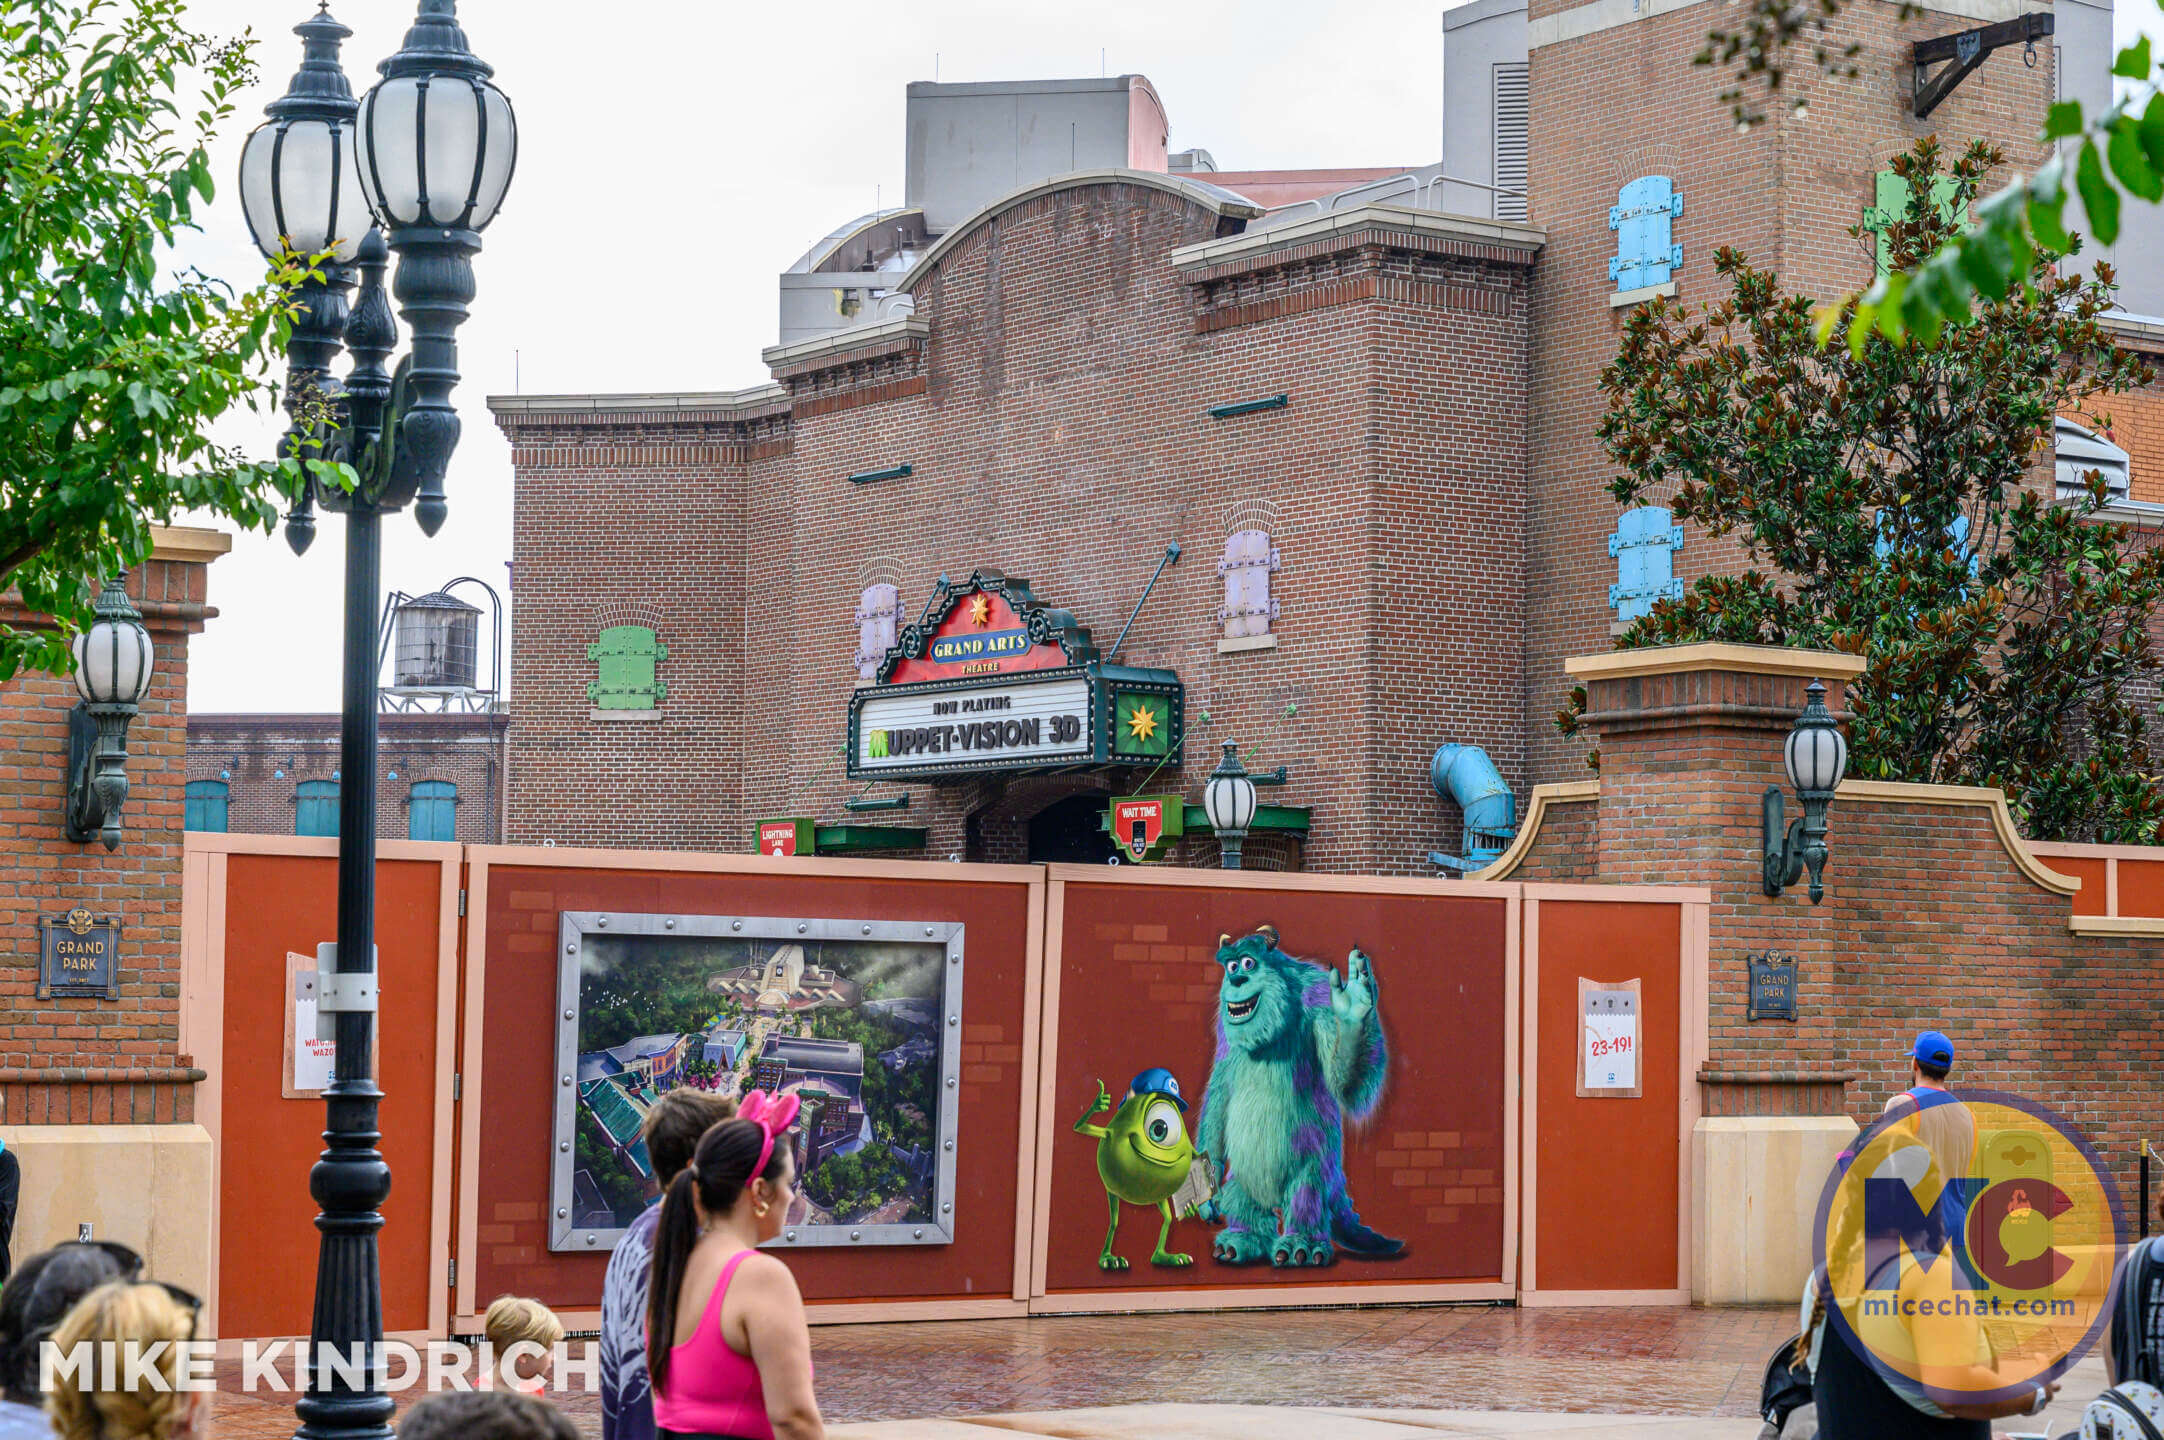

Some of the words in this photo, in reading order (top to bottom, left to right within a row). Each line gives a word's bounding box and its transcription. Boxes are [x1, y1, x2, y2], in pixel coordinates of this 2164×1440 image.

[935, 640, 984, 657] GRAND
[988, 634, 1026, 652] ARTS
[962, 662, 999, 674] THEATRE
[933, 701, 958, 715] NOW
[962, 696, 1011, 713] PLAYING
[1049, 715, 1081, 744] 3D
[1122, 807, 1138, 818] WAIT
[1140, 806, 1157, 817] TIME
[762, 829, 793, 840] LIGHTNING
[57, 941, 104, 954] GRAND
[63, 957, 97, 970] PARK
[1761, 975, 1789, 985] GRAND
[1764, 987, 1785, 998] PARK
[312, 1048, 336, 1056] WAZO
[1591, 1036, 1632, 1056] 23-19!
